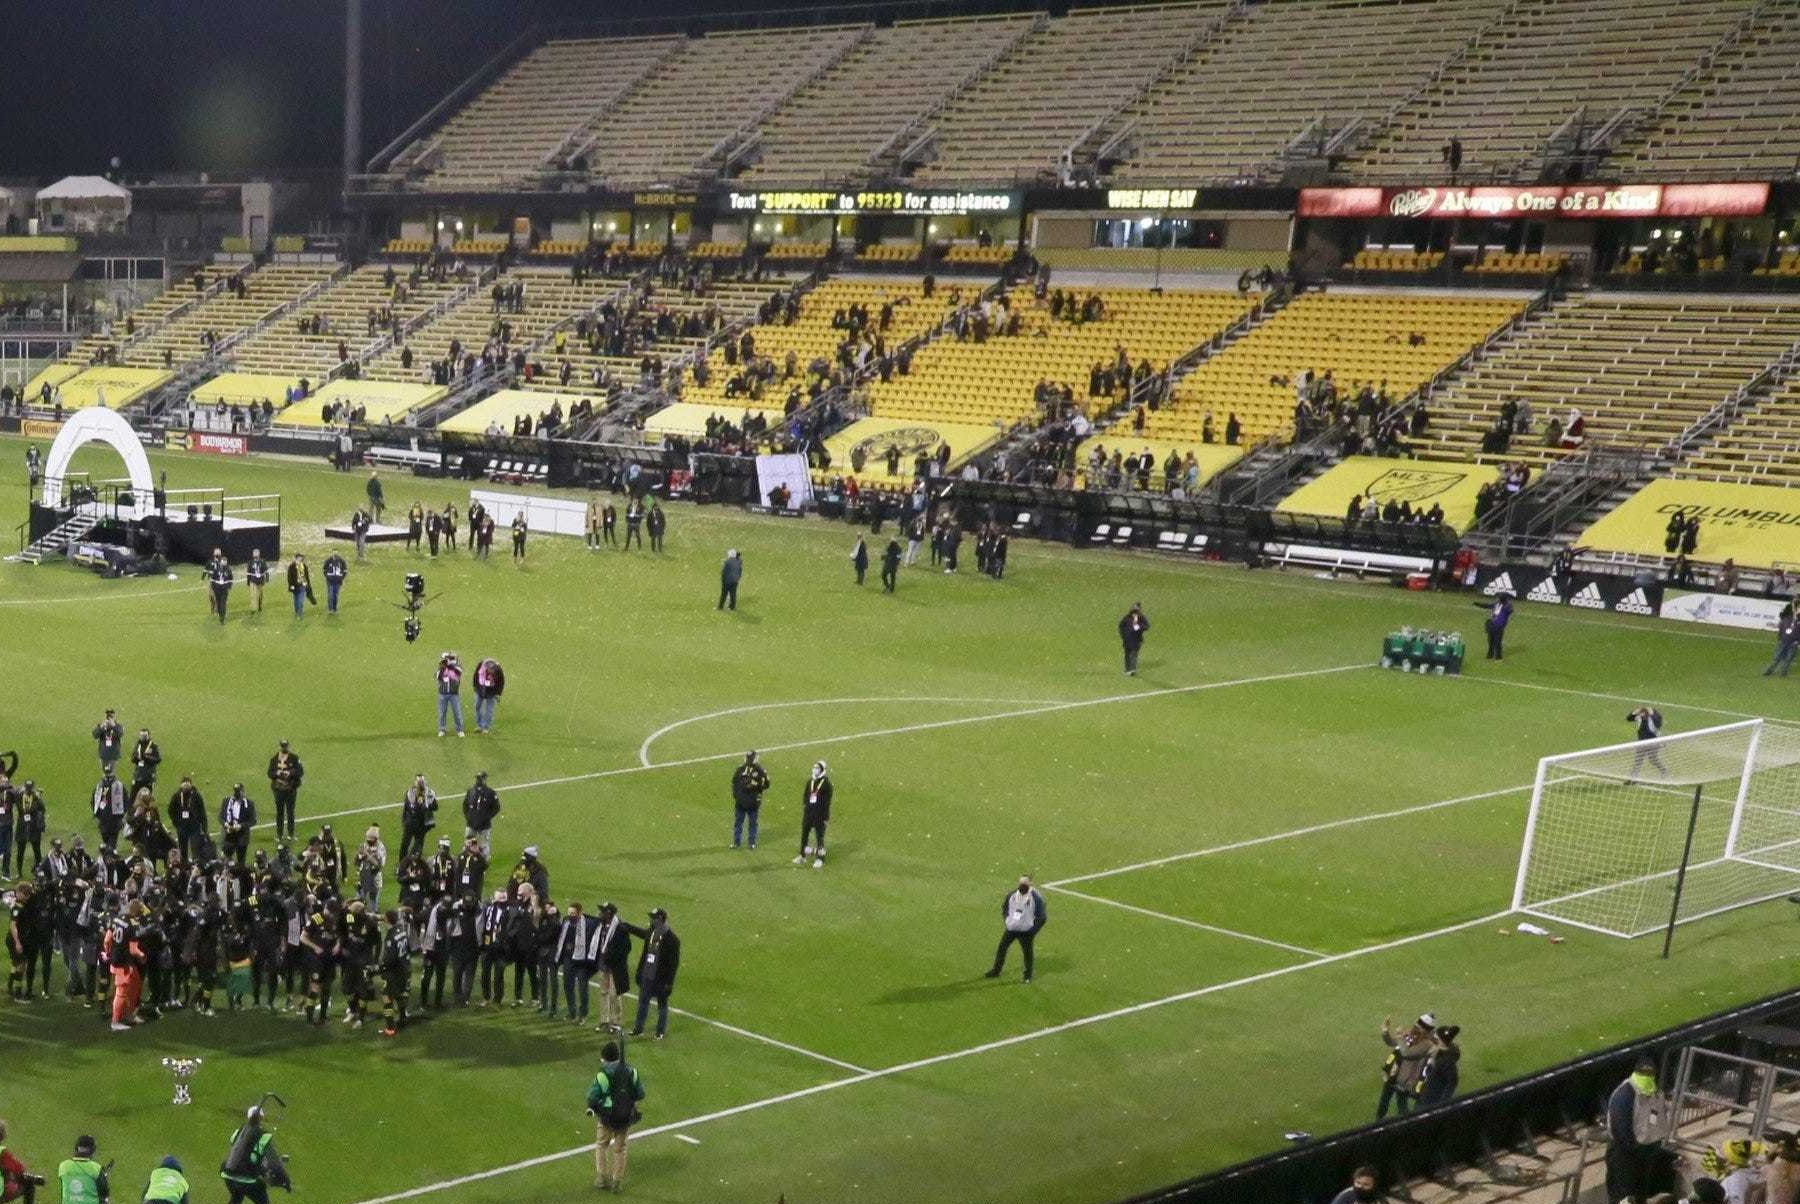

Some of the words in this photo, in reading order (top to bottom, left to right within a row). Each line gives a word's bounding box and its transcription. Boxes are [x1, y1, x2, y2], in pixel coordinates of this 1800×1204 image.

[730, 193, 757, 209] Text
[839, 194, 854, 208] to
[857, 192, 902, 208] 95323
[905, 193, 927, 208] for
[930, 193, 1010, 209] assistance
[1108, 190, 1141, 208] WISE
[1141, 190, 1169, 208] MEN
[1170, 190, 1197, 208] SAY
[1439, 191, 1514, 214] Always
[1517, 193, 1556, 210] One
[1560, 192, 1582, 210] of
[1585, 196, 1599, 210] a
[1602, 190, 1658, 210] Kind
[1656, 503, 1800, 527] COLUMBU
[1615, 602, 1652, 615] adidas
